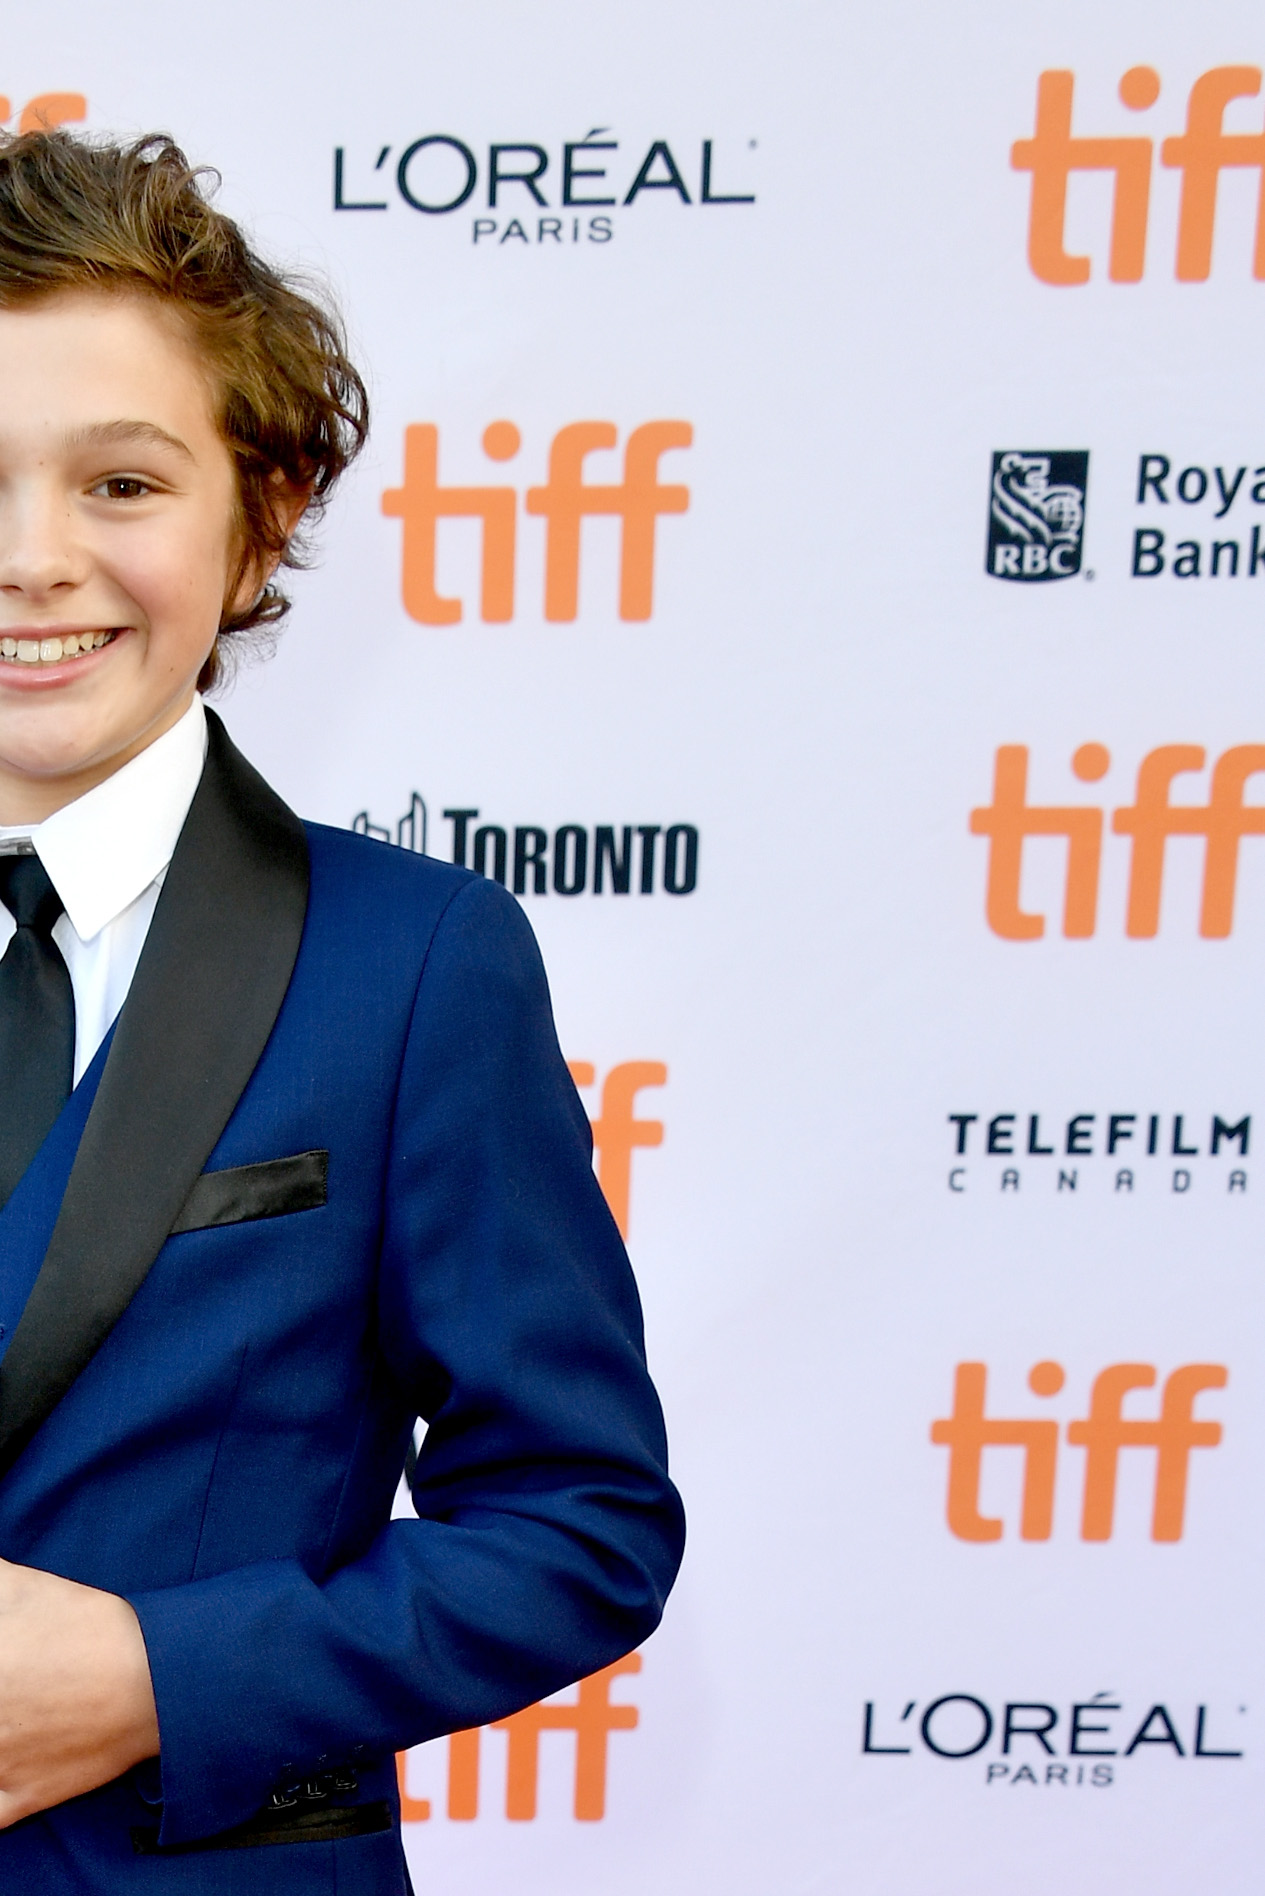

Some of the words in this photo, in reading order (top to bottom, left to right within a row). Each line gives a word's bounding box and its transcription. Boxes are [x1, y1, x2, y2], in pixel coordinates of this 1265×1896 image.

[334, 127, 755, 215] L'ORÉAL
[1011, 65, 1265, 286] tif
[472, 216, 614, 245] PARIS
[381, 420, 693, 626] tiff
[993, 543, 1078, 575] RBC
[947, 1113, 1252, 1156] TELEFILM
[948, 1167, 1248, 1193] CANADA
[930, 1360, 1228, 1543] tiff
[862, 1691, 1244, 1759] L'ORÉAL
[985, 1762, 1116, 1788] PARIS
